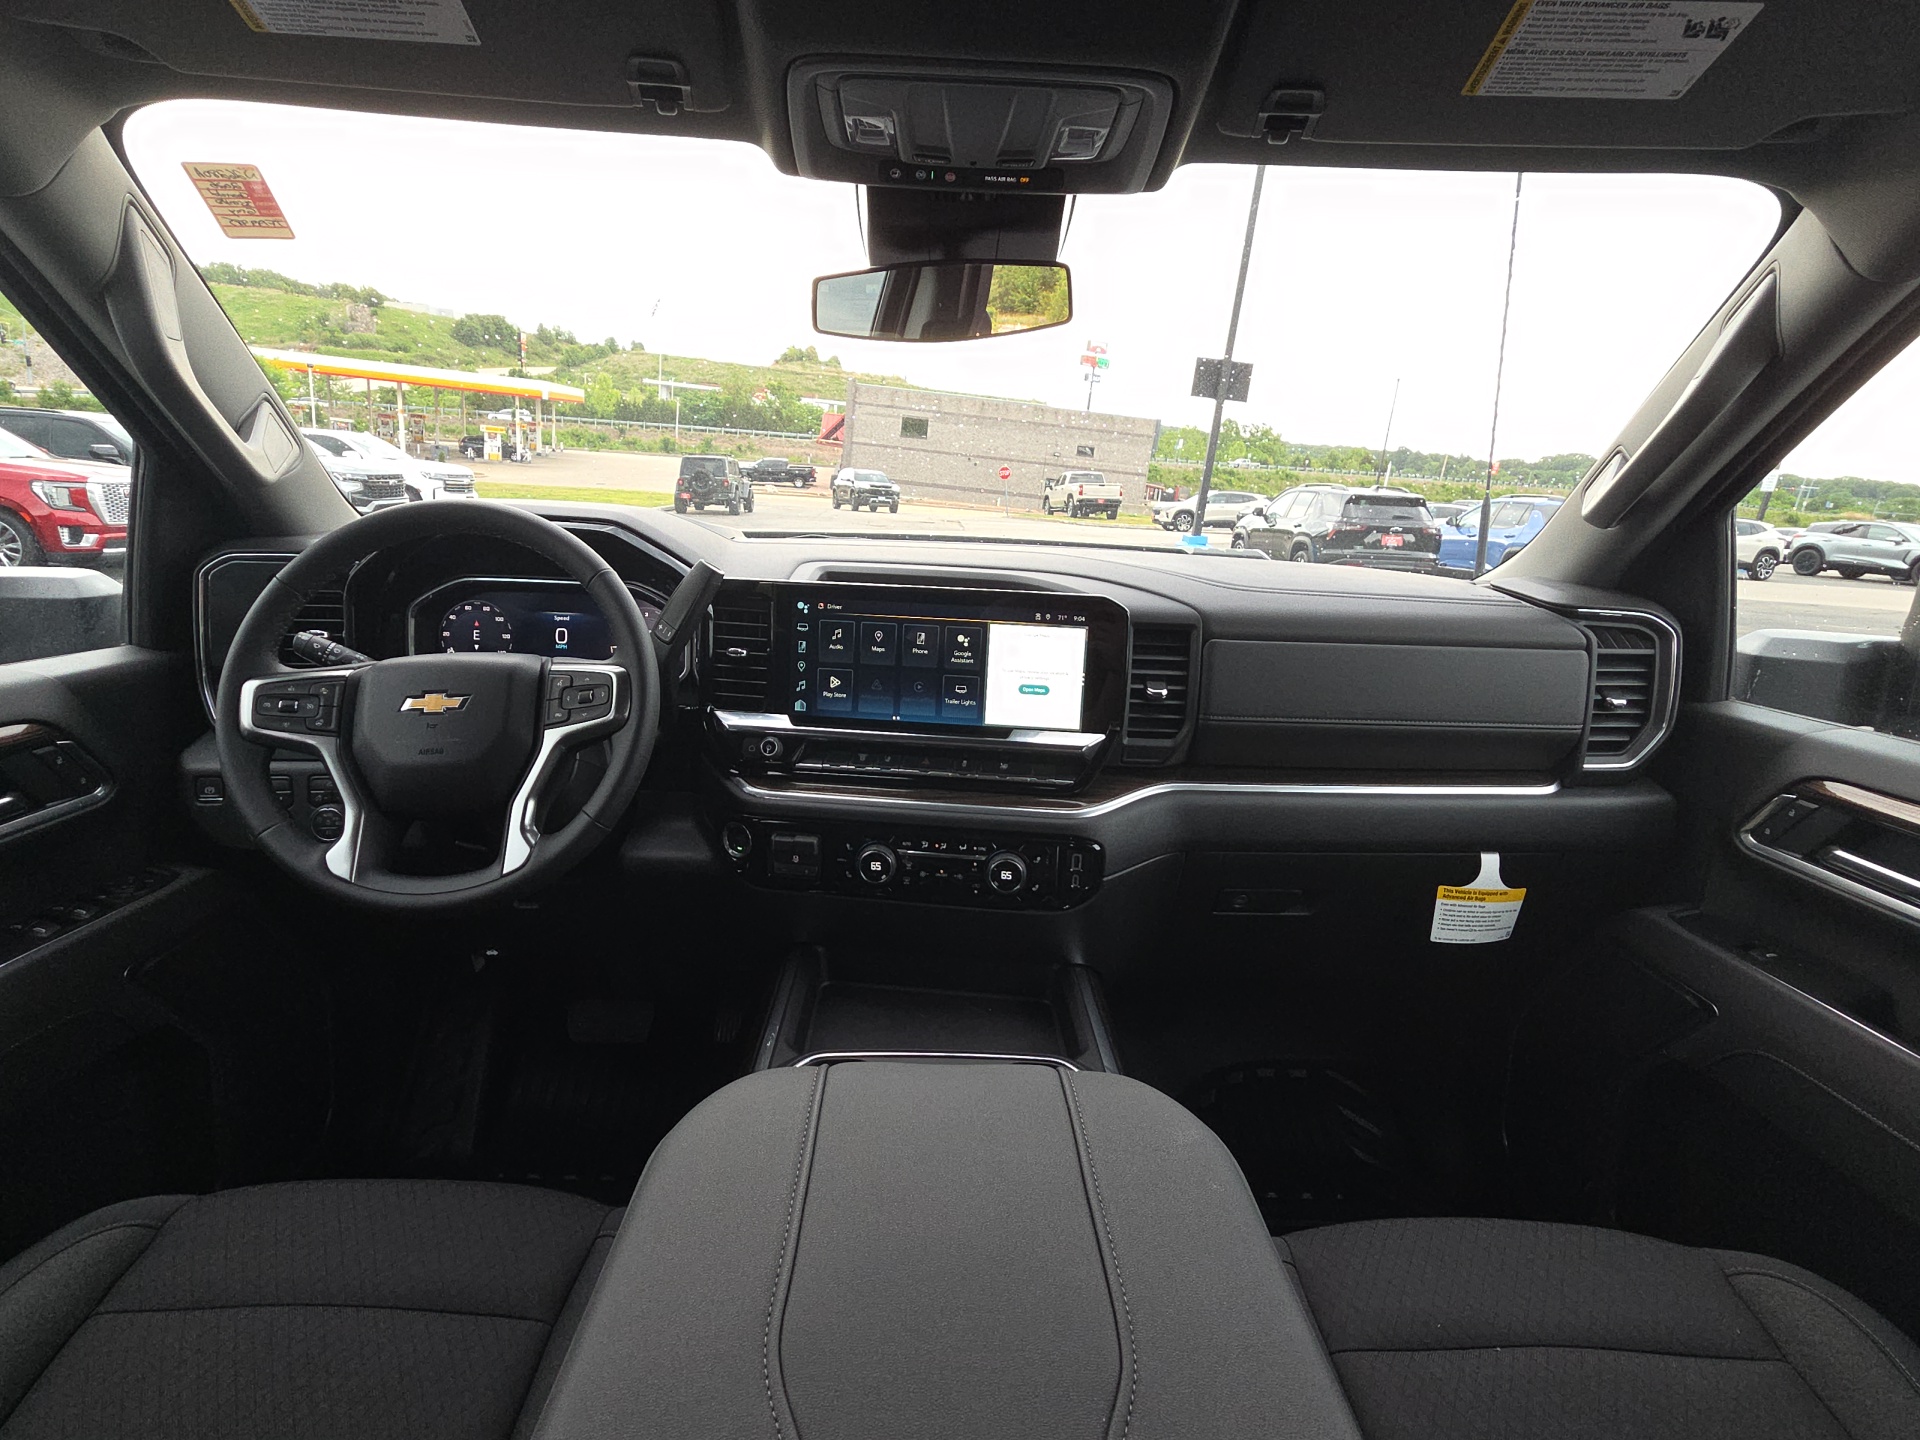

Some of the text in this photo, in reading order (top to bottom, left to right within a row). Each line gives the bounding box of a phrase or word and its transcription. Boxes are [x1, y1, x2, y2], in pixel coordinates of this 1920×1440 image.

[473, 630, 480, 640] E
[555, 628, 568, 644] 0
[870, 862, 882, 871] 65
[1000, 871, 1012, 880] 65
